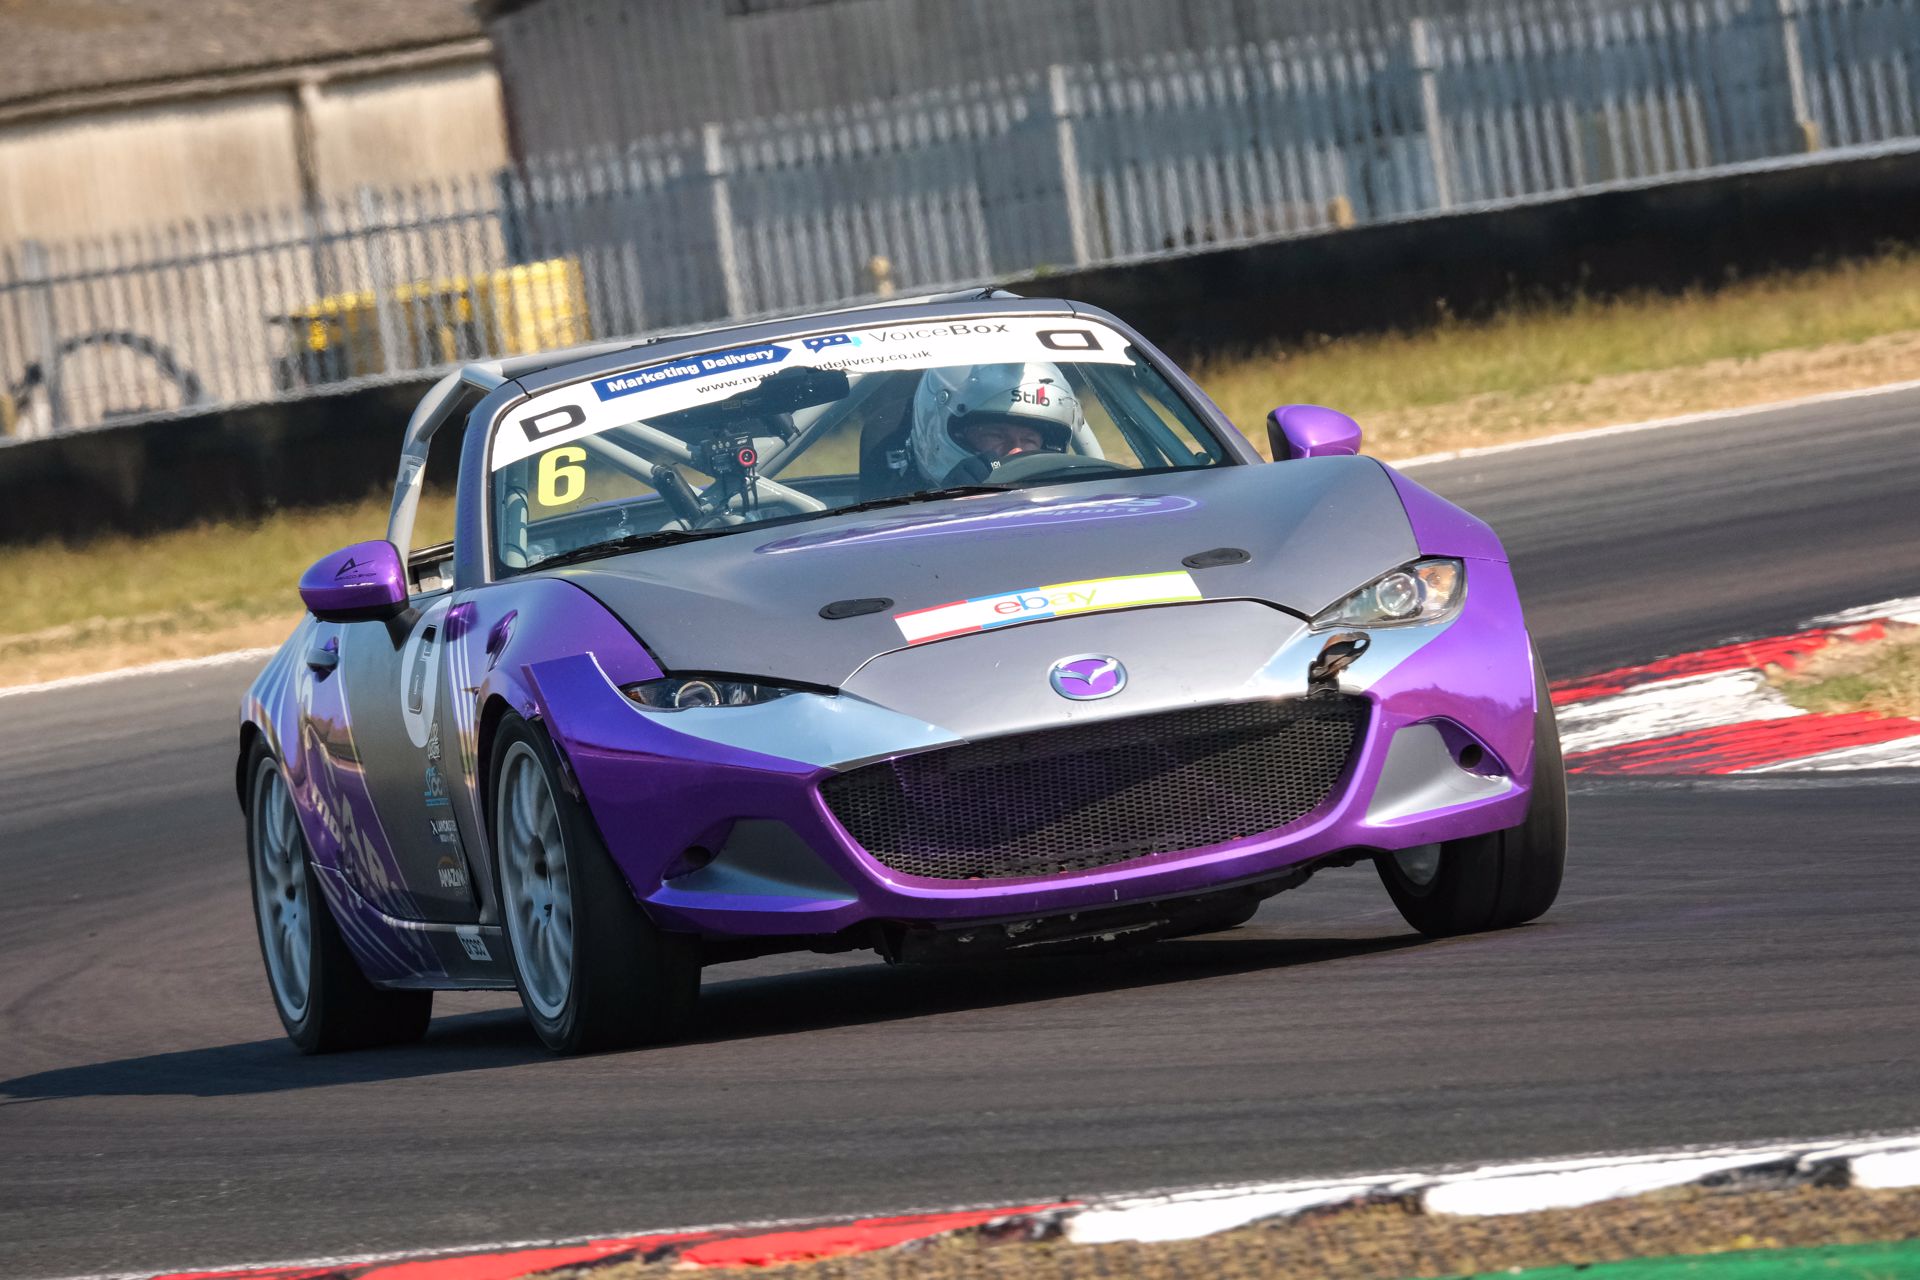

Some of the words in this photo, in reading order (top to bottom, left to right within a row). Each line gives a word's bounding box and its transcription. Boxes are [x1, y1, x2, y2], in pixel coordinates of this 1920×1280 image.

[869, 323, 1010, 342] VoiceBox
[606, 363, 700, 393] Marketing
[701, 350, 775, 371] Delivery
[1011, 386, 1050, 407] Stilo
[537, 446, 587, 507] 6
[993, 588, 1097, 615] ebay
